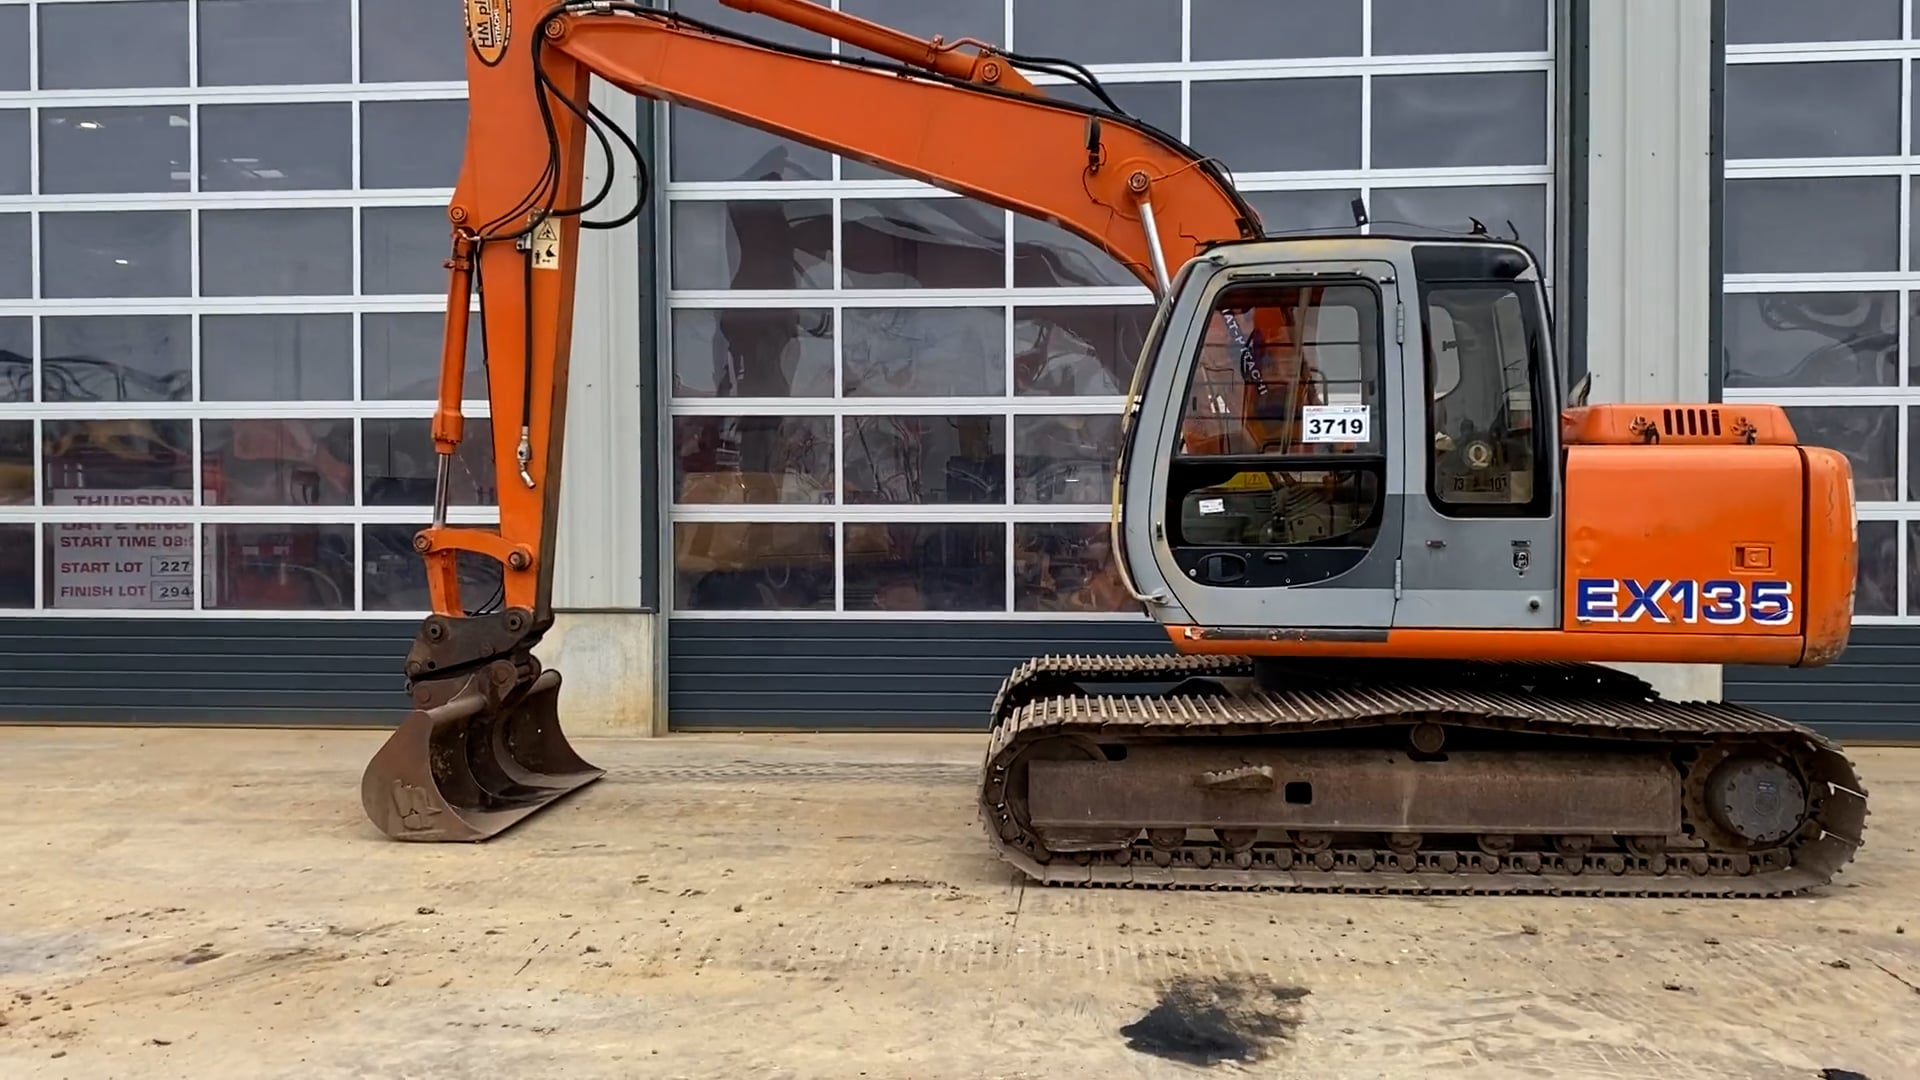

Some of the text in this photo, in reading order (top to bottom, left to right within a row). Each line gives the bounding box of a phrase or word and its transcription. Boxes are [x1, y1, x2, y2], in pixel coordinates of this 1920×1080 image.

[477, 21, 489, 47] HM
[1222, 309, 1269, 395] IAT-HITACHI
[1309, 419, 1363, 434] 3719
[61, 536, 112, 547] START
[117, 536, 156, 547] TIME
[61, 562, 110, 573] START
[115, 562, 143, 573] LOT
[61, 586, 194, 598] FINISH LOT 294
[1577, 578, 1794, 624] EX135
